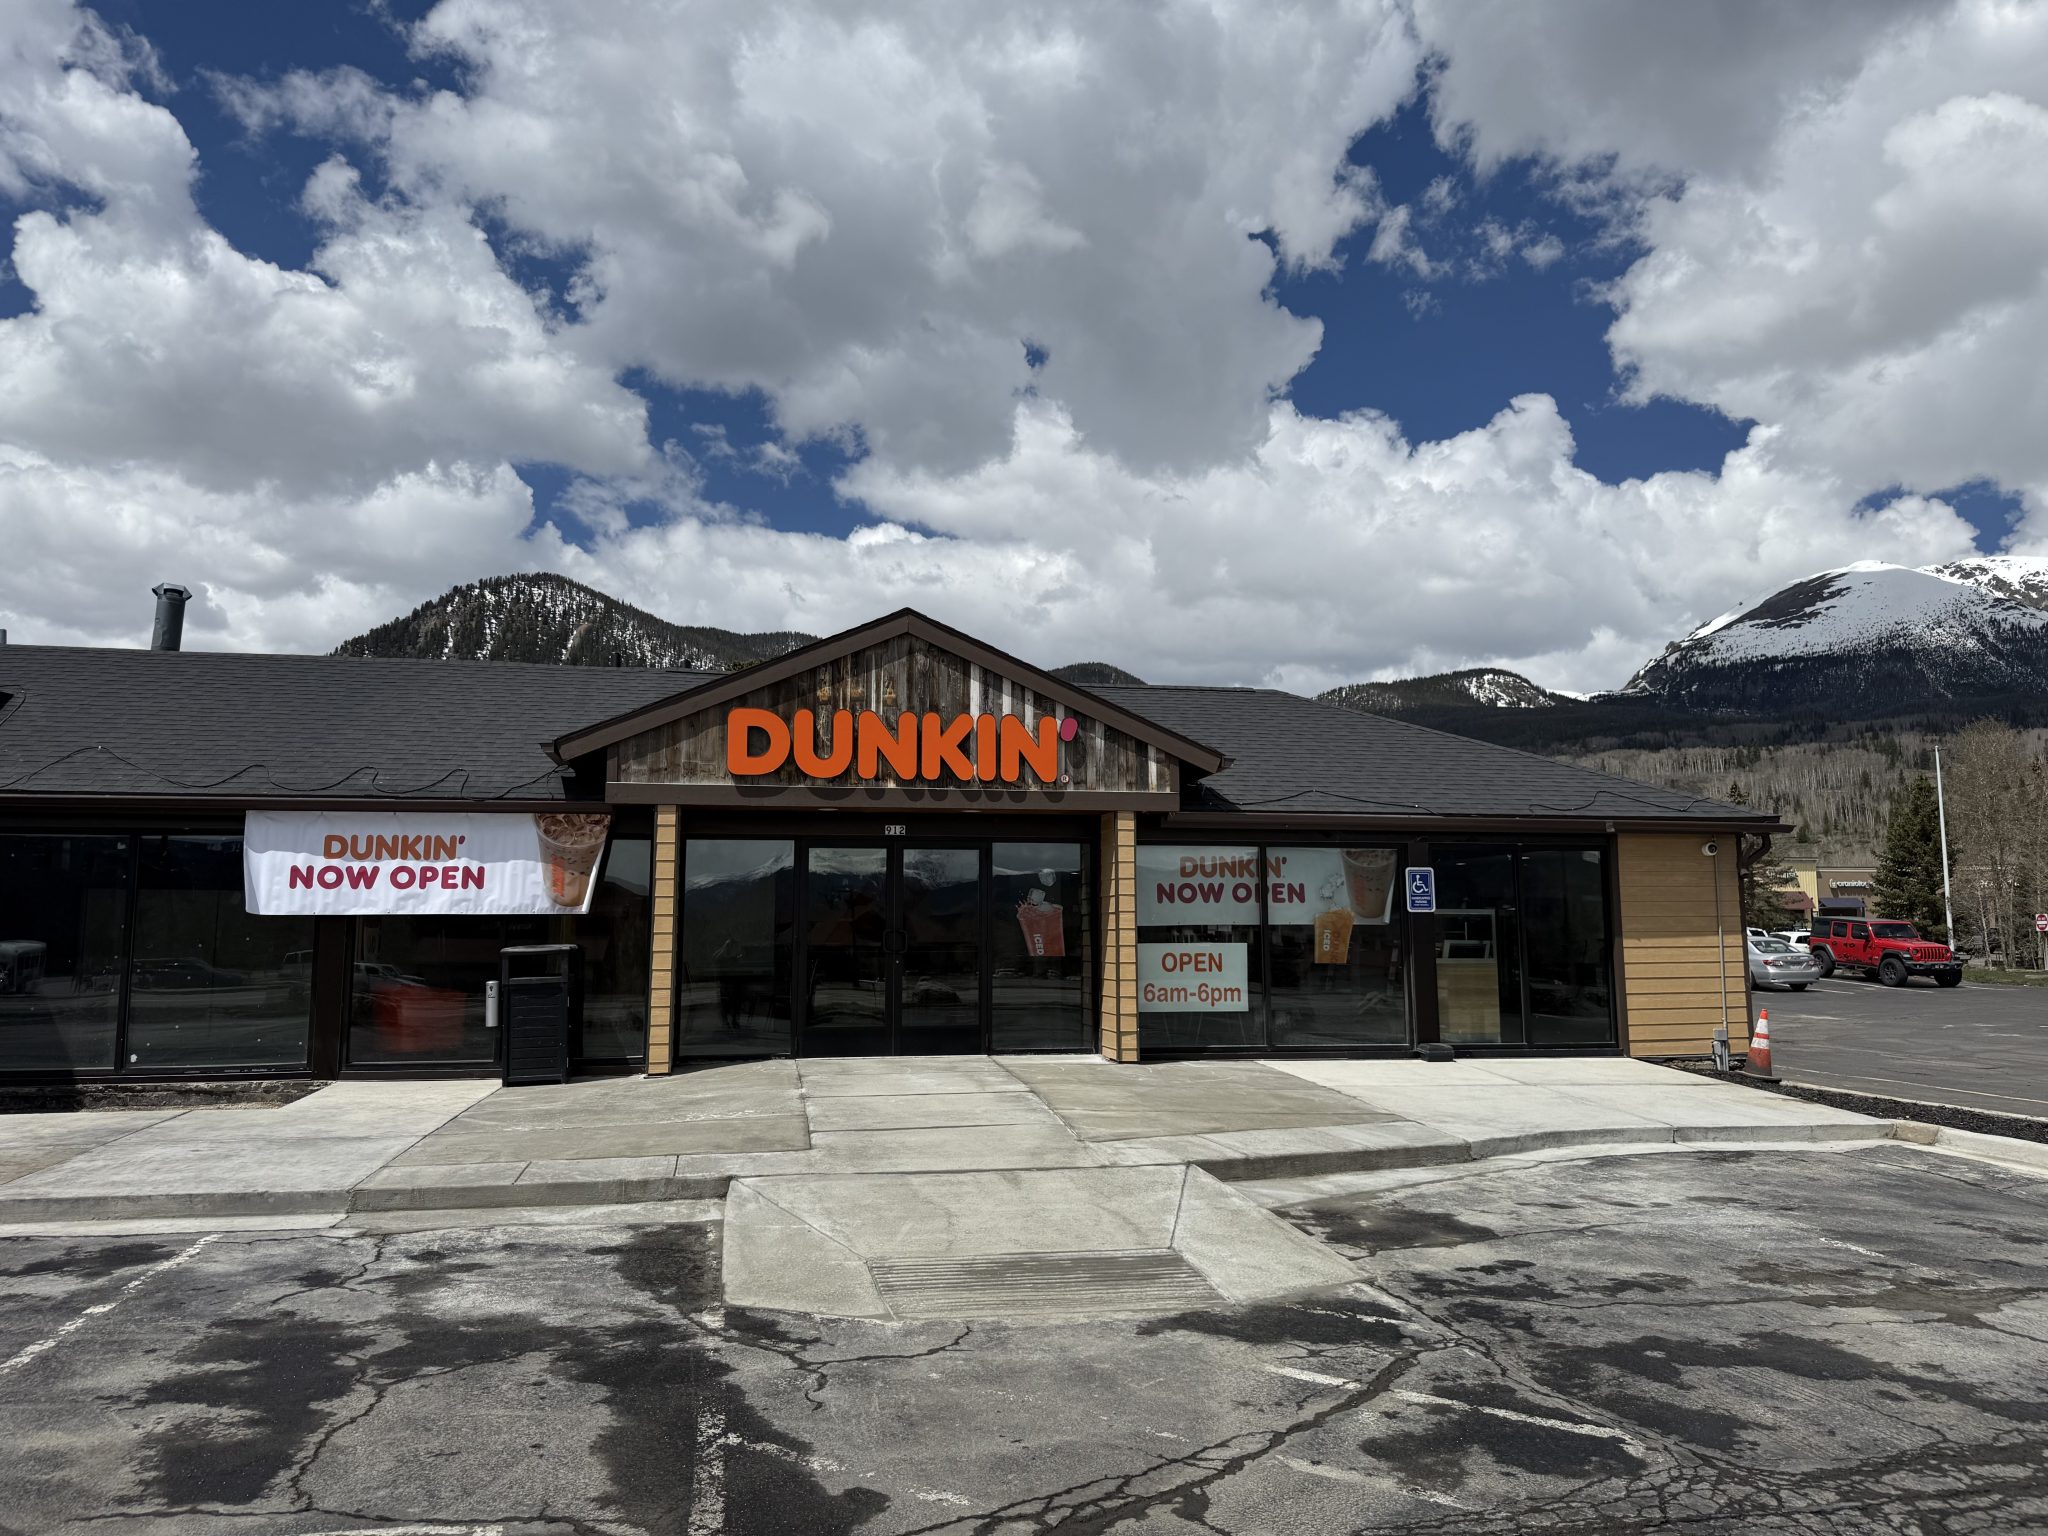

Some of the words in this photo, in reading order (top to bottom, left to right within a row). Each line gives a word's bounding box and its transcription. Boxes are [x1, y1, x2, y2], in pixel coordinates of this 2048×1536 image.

[727, 707, 1078, 783] DUNKIN'
[886, 826, 905, 835] 912
[323, 834, 465, 861] DUNKIN'
[289, 865, 380, 890] NOW
[390, 865, 485, 890] OPEN
[1156, 883, 1225, 904] NOW
[1033, 933, 1045, 955] ICED
[1323, 929, 1331, 951] ICED
[1161, 952, 1223, 972] OPEN
[1143, 983, 1242, 1007] 6am-6pm
